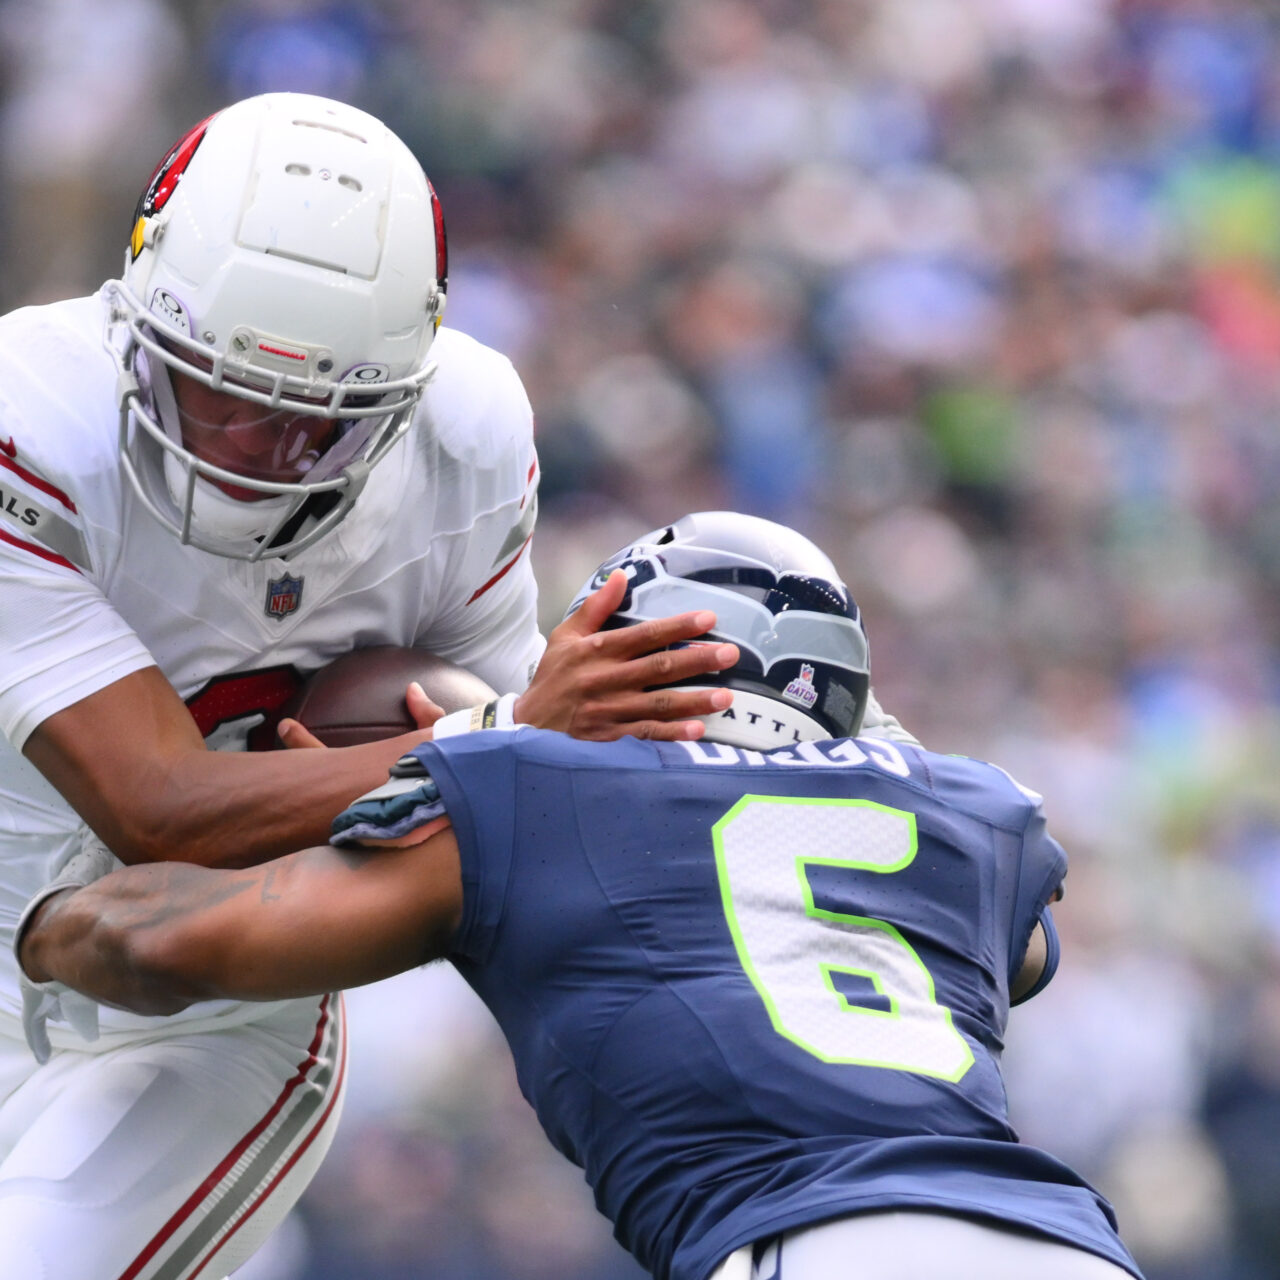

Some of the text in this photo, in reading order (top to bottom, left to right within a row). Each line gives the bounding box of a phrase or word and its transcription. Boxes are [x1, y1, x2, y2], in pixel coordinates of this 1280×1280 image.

[271, 593, 297, 613] NFL
[786, 683, 817, 704] CATCH
[712, 793, 975, 1084] 6
